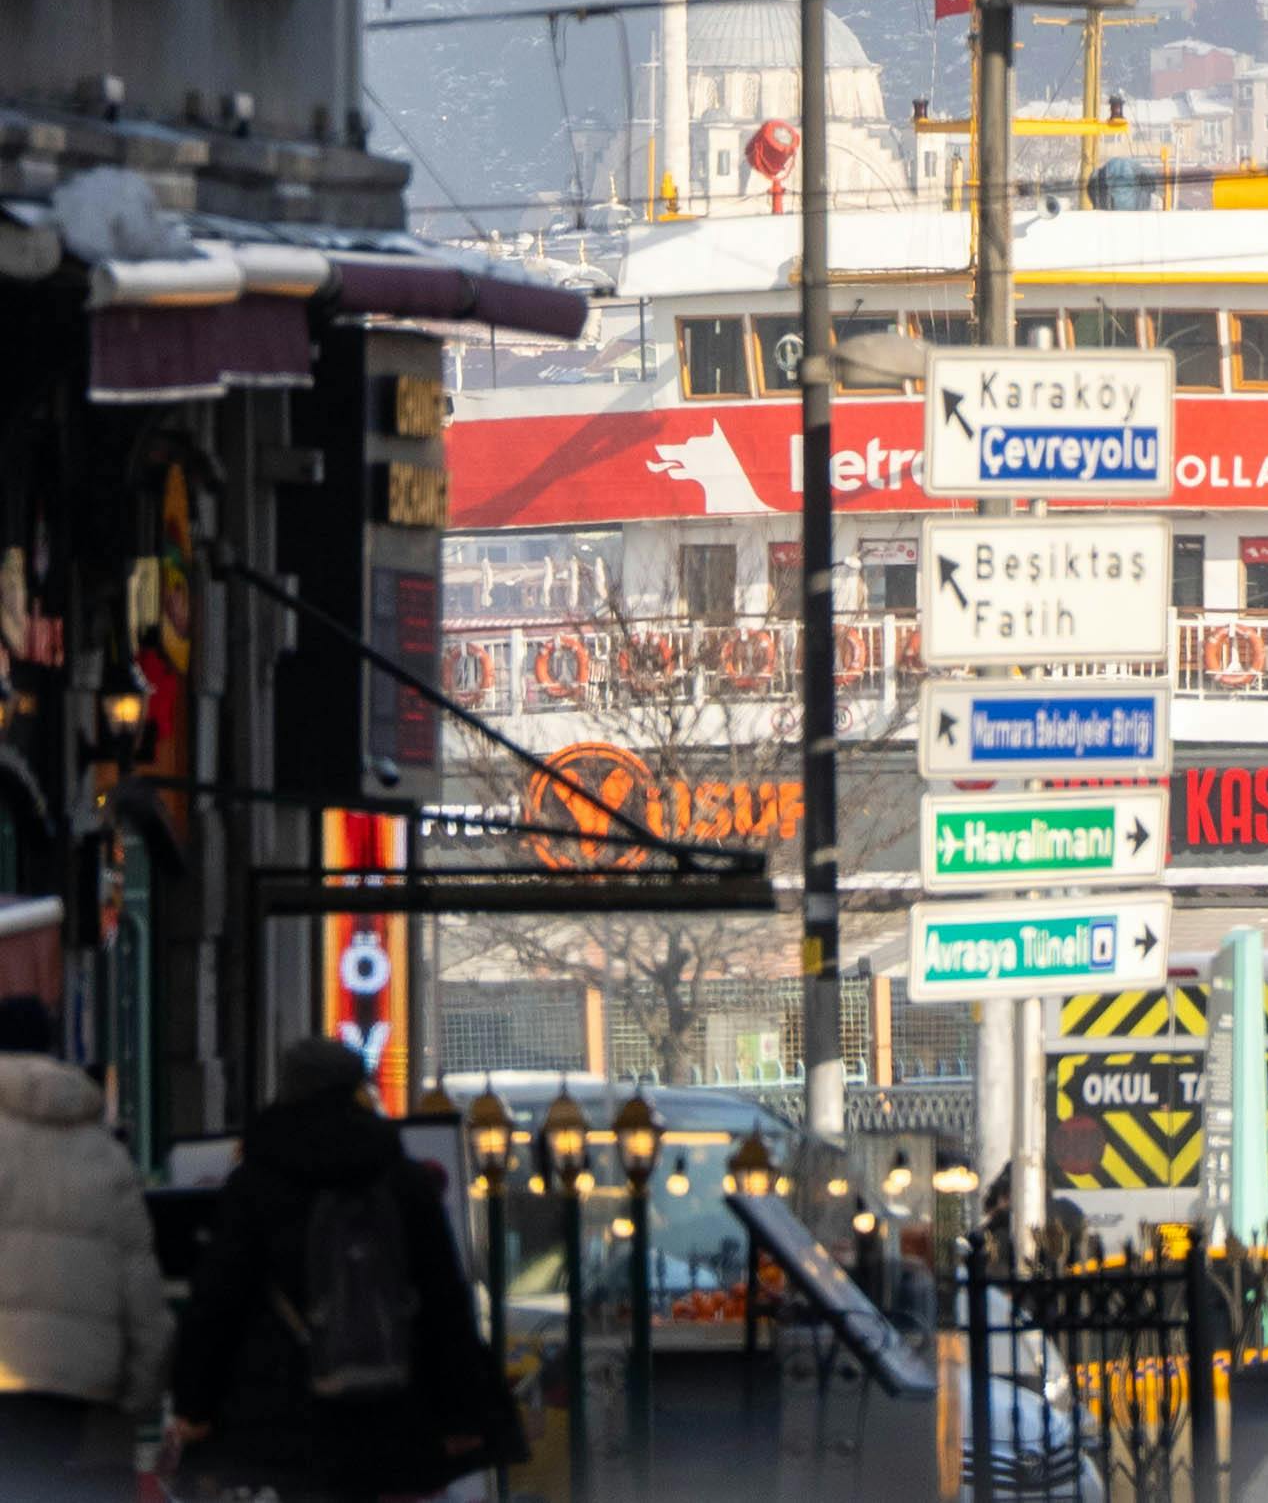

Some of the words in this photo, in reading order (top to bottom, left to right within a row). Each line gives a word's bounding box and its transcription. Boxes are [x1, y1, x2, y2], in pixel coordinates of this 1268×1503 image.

[979, 370, 1141, 423] Karaköy
[982, 426, 1157, 481] Çevreyolu
[975, 542, 1146, 584] Beşiktaş
[974, 598, 1076, 638] Fatih
[964, 818, 1113, 864] Havalimanı
[926, 930, 1018, 980] Avrasya
[1020, 924, 1090, 969] Tüneli
[1082, 1072, 1159, 1104] OKUL
